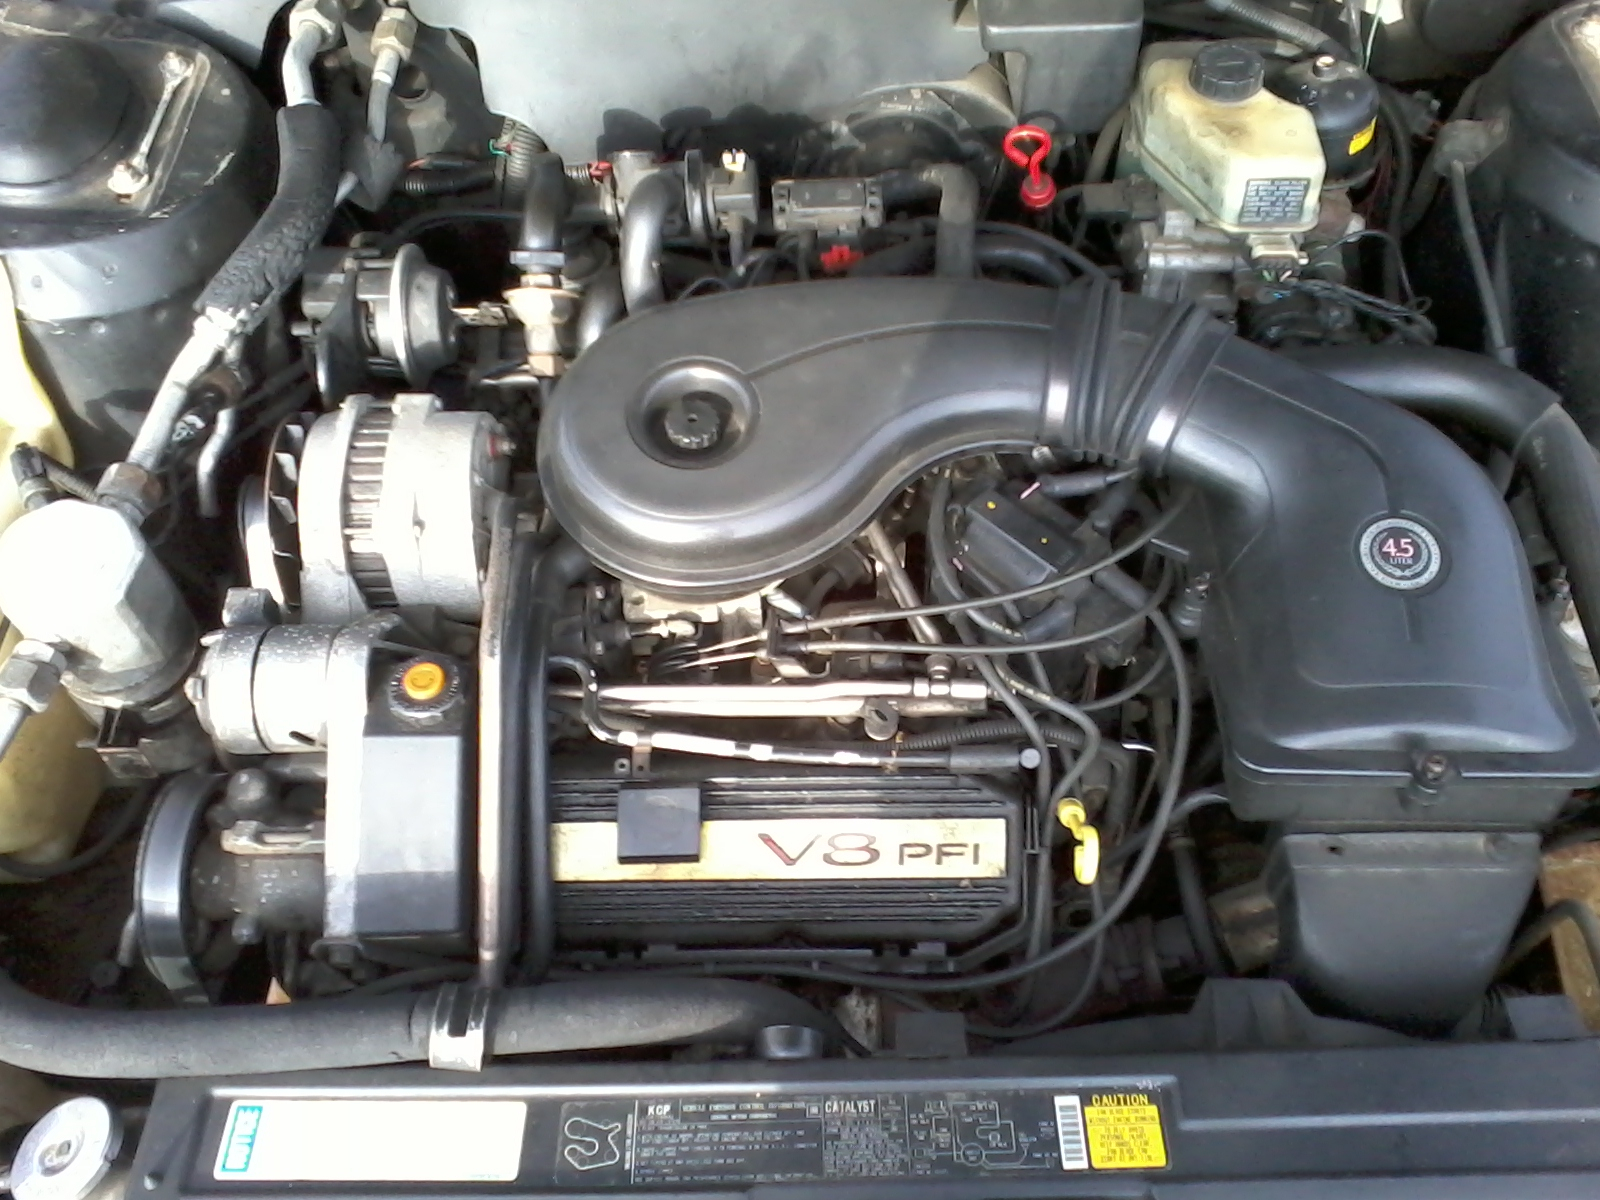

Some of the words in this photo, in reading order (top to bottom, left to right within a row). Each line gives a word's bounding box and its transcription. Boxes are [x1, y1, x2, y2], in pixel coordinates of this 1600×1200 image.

[757, 832, 881, 867] V8
[898, 842, 980, 866] PFI
[824, 1099, 877, 1114] CATALYST
[1091, 1093, 1149, 1108] CAUTION
